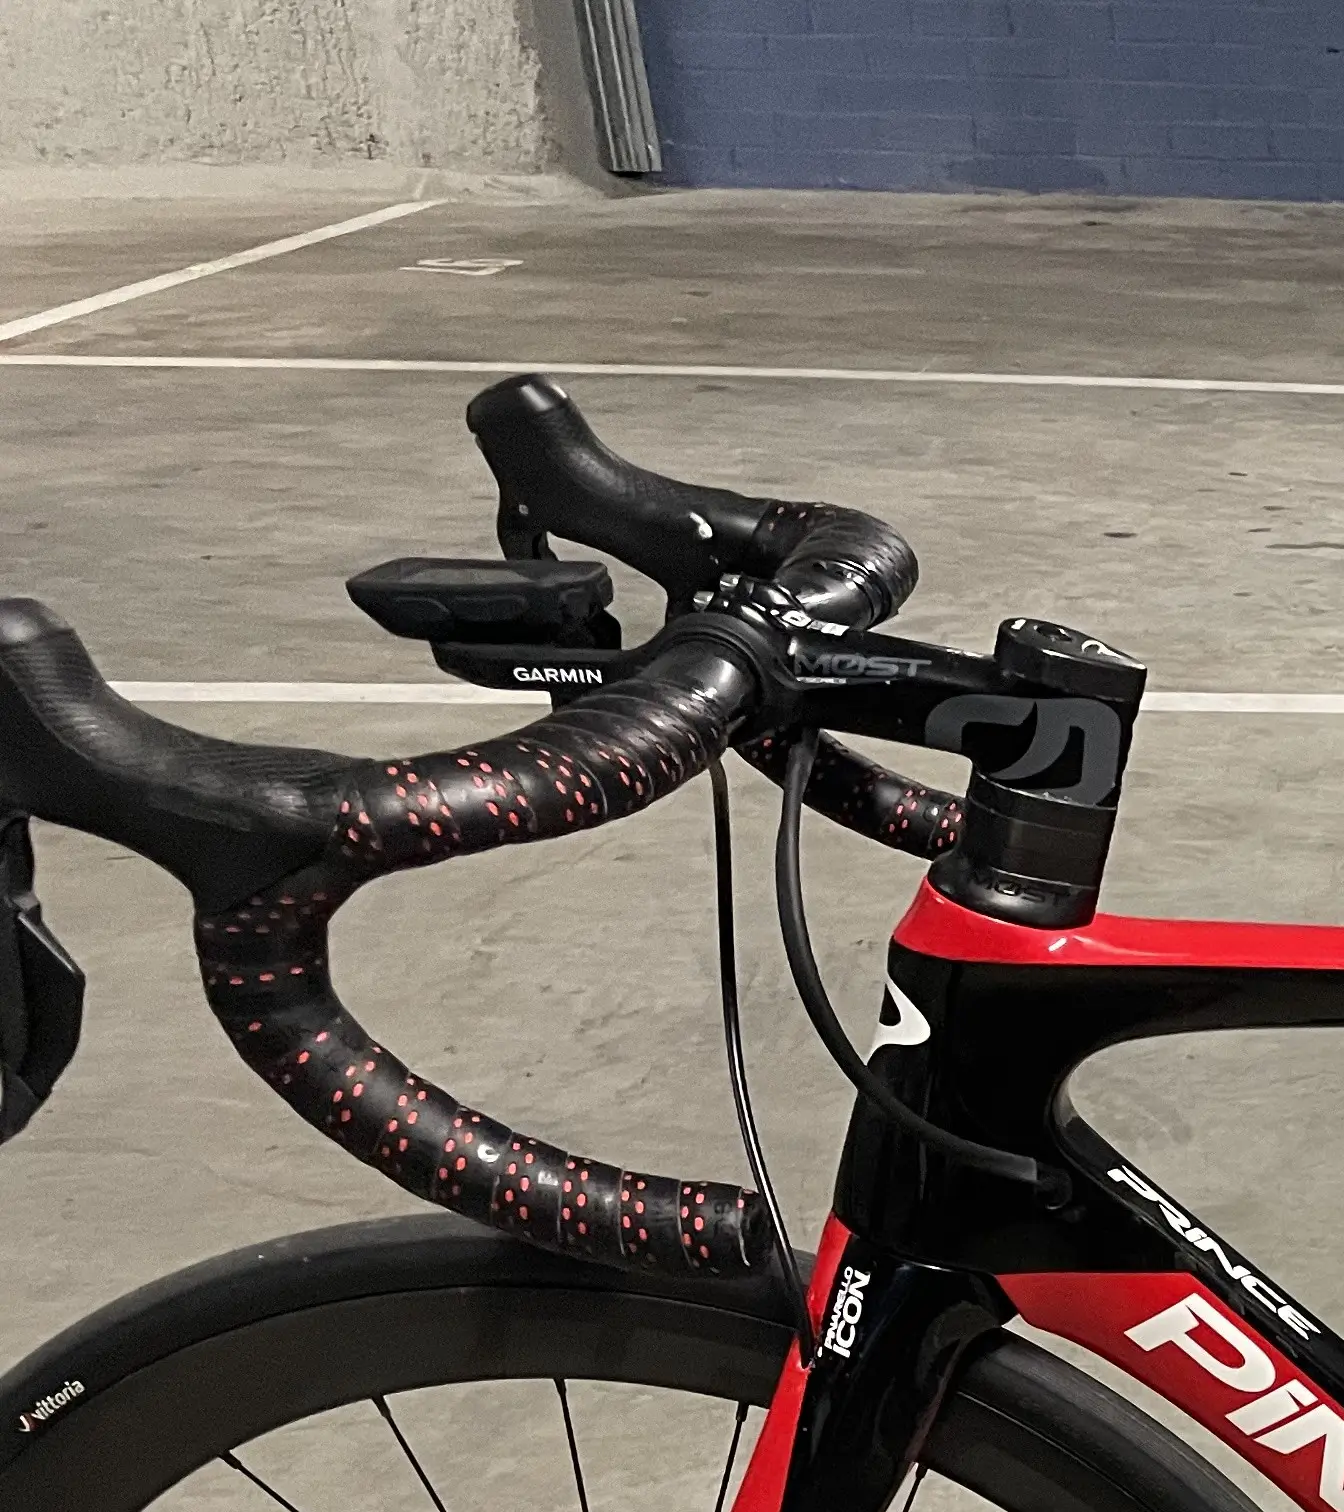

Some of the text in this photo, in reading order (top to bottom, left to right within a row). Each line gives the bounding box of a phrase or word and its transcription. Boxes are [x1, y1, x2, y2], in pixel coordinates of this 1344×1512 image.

[512, 666, 603, 684] GARMIN
[1106, 1164, 1322, 1341] PRINCE
[832, 1269, 871, 1358] ICON
